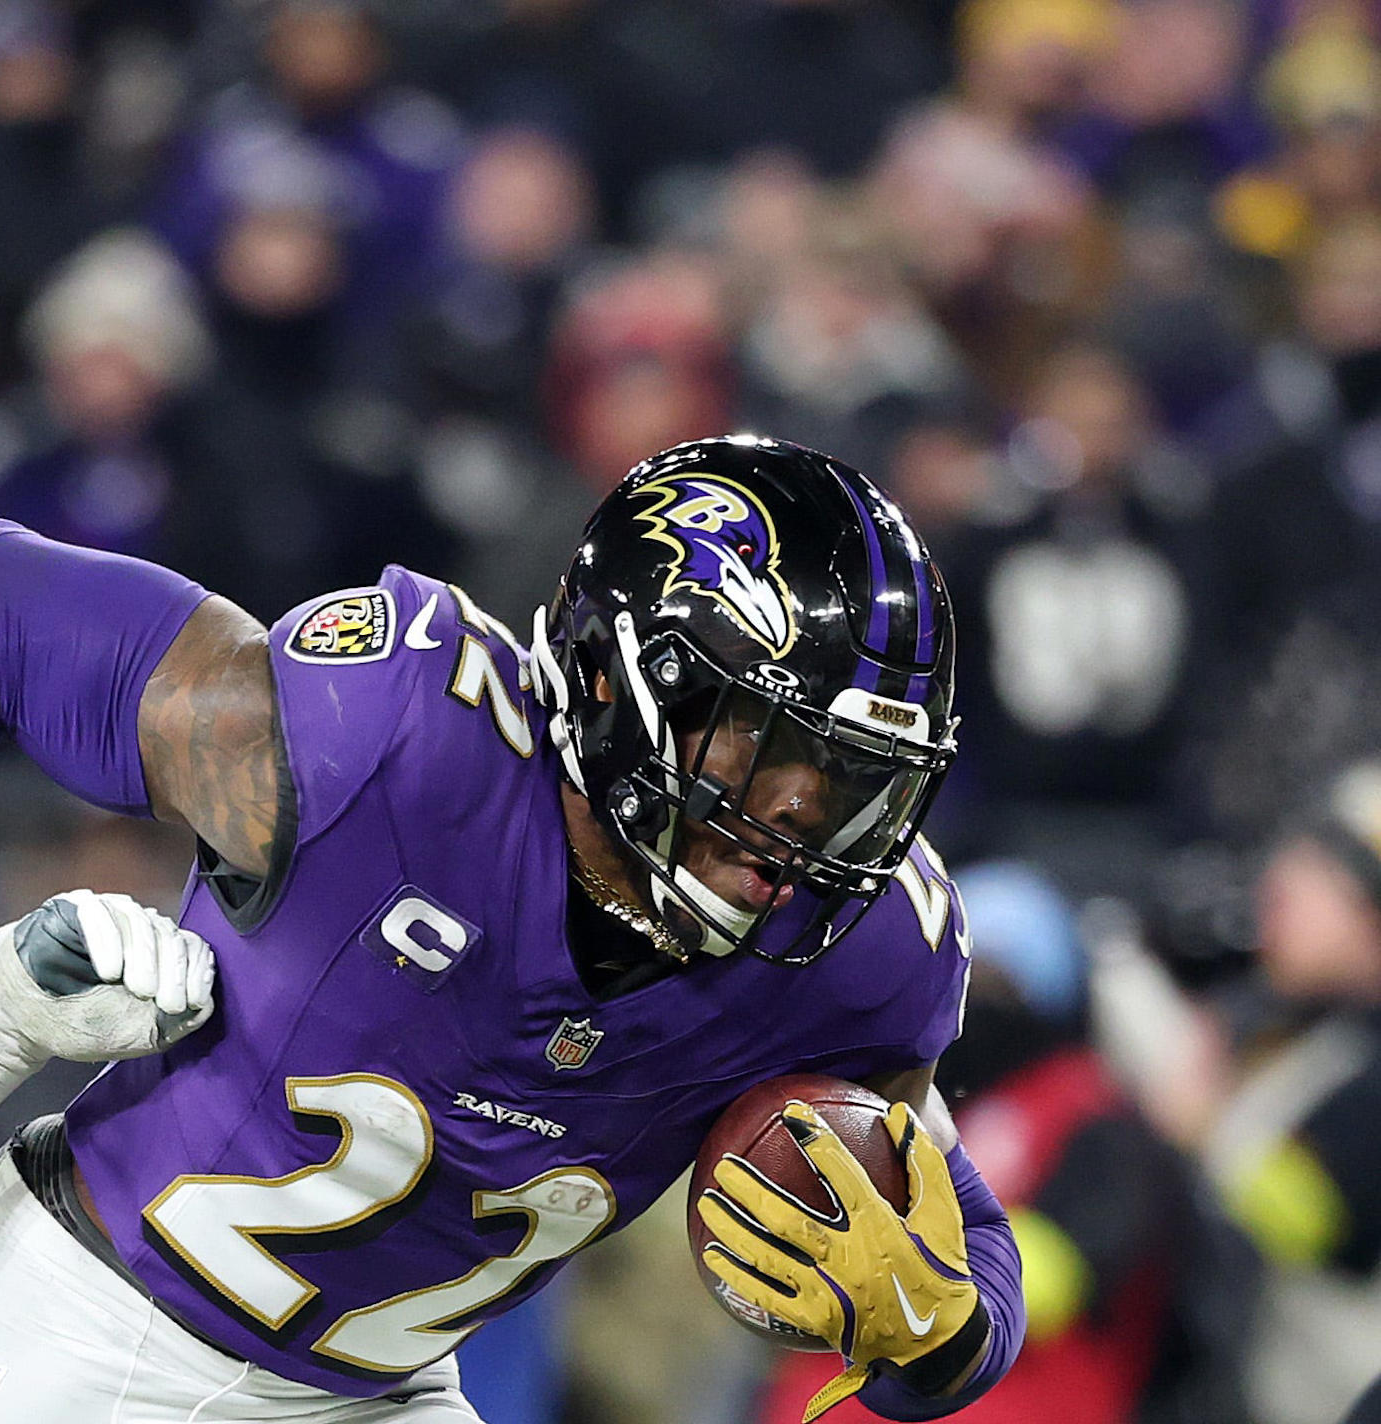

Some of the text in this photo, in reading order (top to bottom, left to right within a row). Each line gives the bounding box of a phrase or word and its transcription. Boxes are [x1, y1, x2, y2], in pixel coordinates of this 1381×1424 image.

[370, 595, 387, 650] RAVENS
[744, 670, 808, 701] OAKLEY
[867, 699, 919, 729] RAVENS
[381, 897, 468, 972] C
[551, 1039, 584, 1064] NFL
[452, 1092, 567, 1139] RAVENS
[142, 1072, 617, 1373] 22
